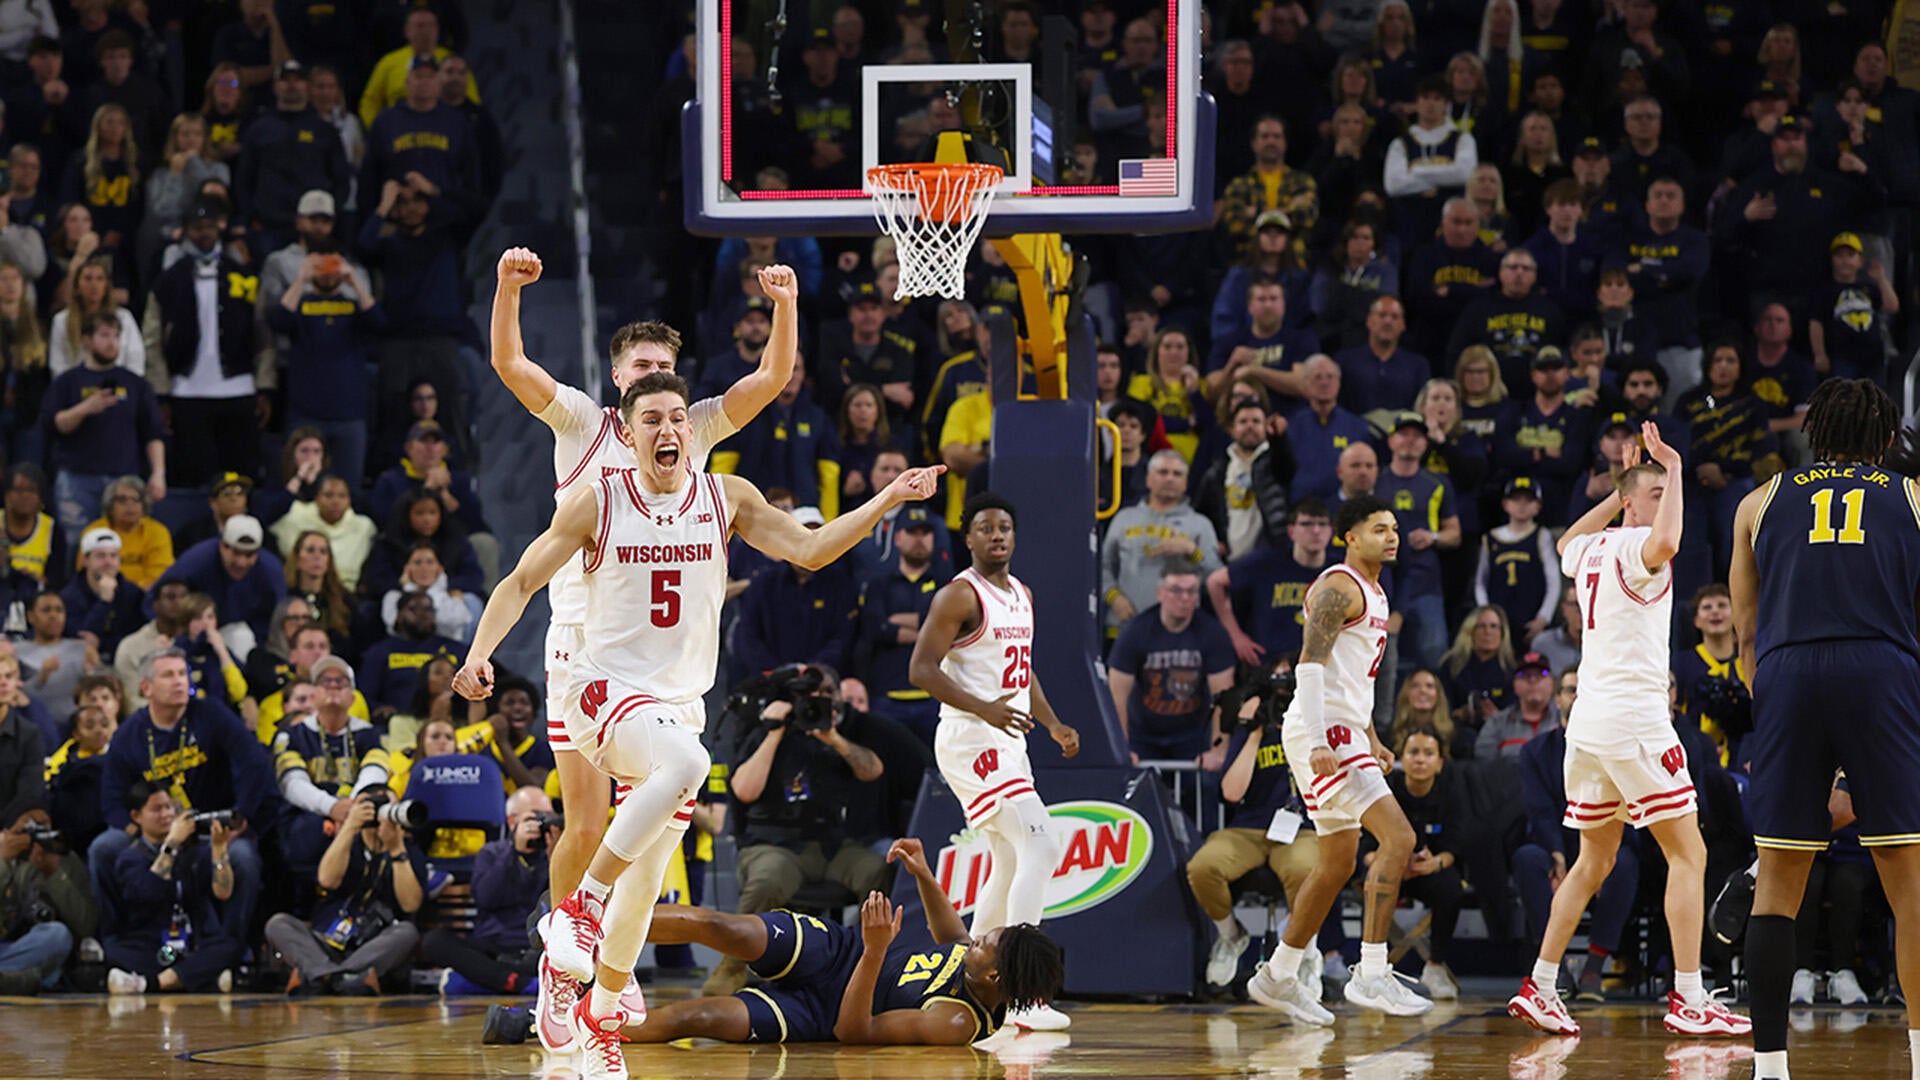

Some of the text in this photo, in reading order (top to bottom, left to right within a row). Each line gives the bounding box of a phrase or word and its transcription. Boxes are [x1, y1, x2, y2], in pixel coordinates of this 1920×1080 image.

[227, 271, 259, 303] M
[1793, 467, 1890, 488] GAYLE JR.
[1808, 488, 1865, 544] 11
[616, 543, 713, 563] WISCONSIN
[1506, 561, 1518, 586] 1
[650, 570, 681, 628] 5
[1586, 573, 1600, 629] 7
[1002, 645, 1030, 689] 25
[580, 679, 608, 720] W
[1327, 725, 1351, 750] W
[434, 766, 480, 777] UMCU
[973, 748, 999, 780] W
[1661, 745, 1684, 777] W
[940, 820, 1133, 912] LIAN
[897, 952, 944, 987] 21
